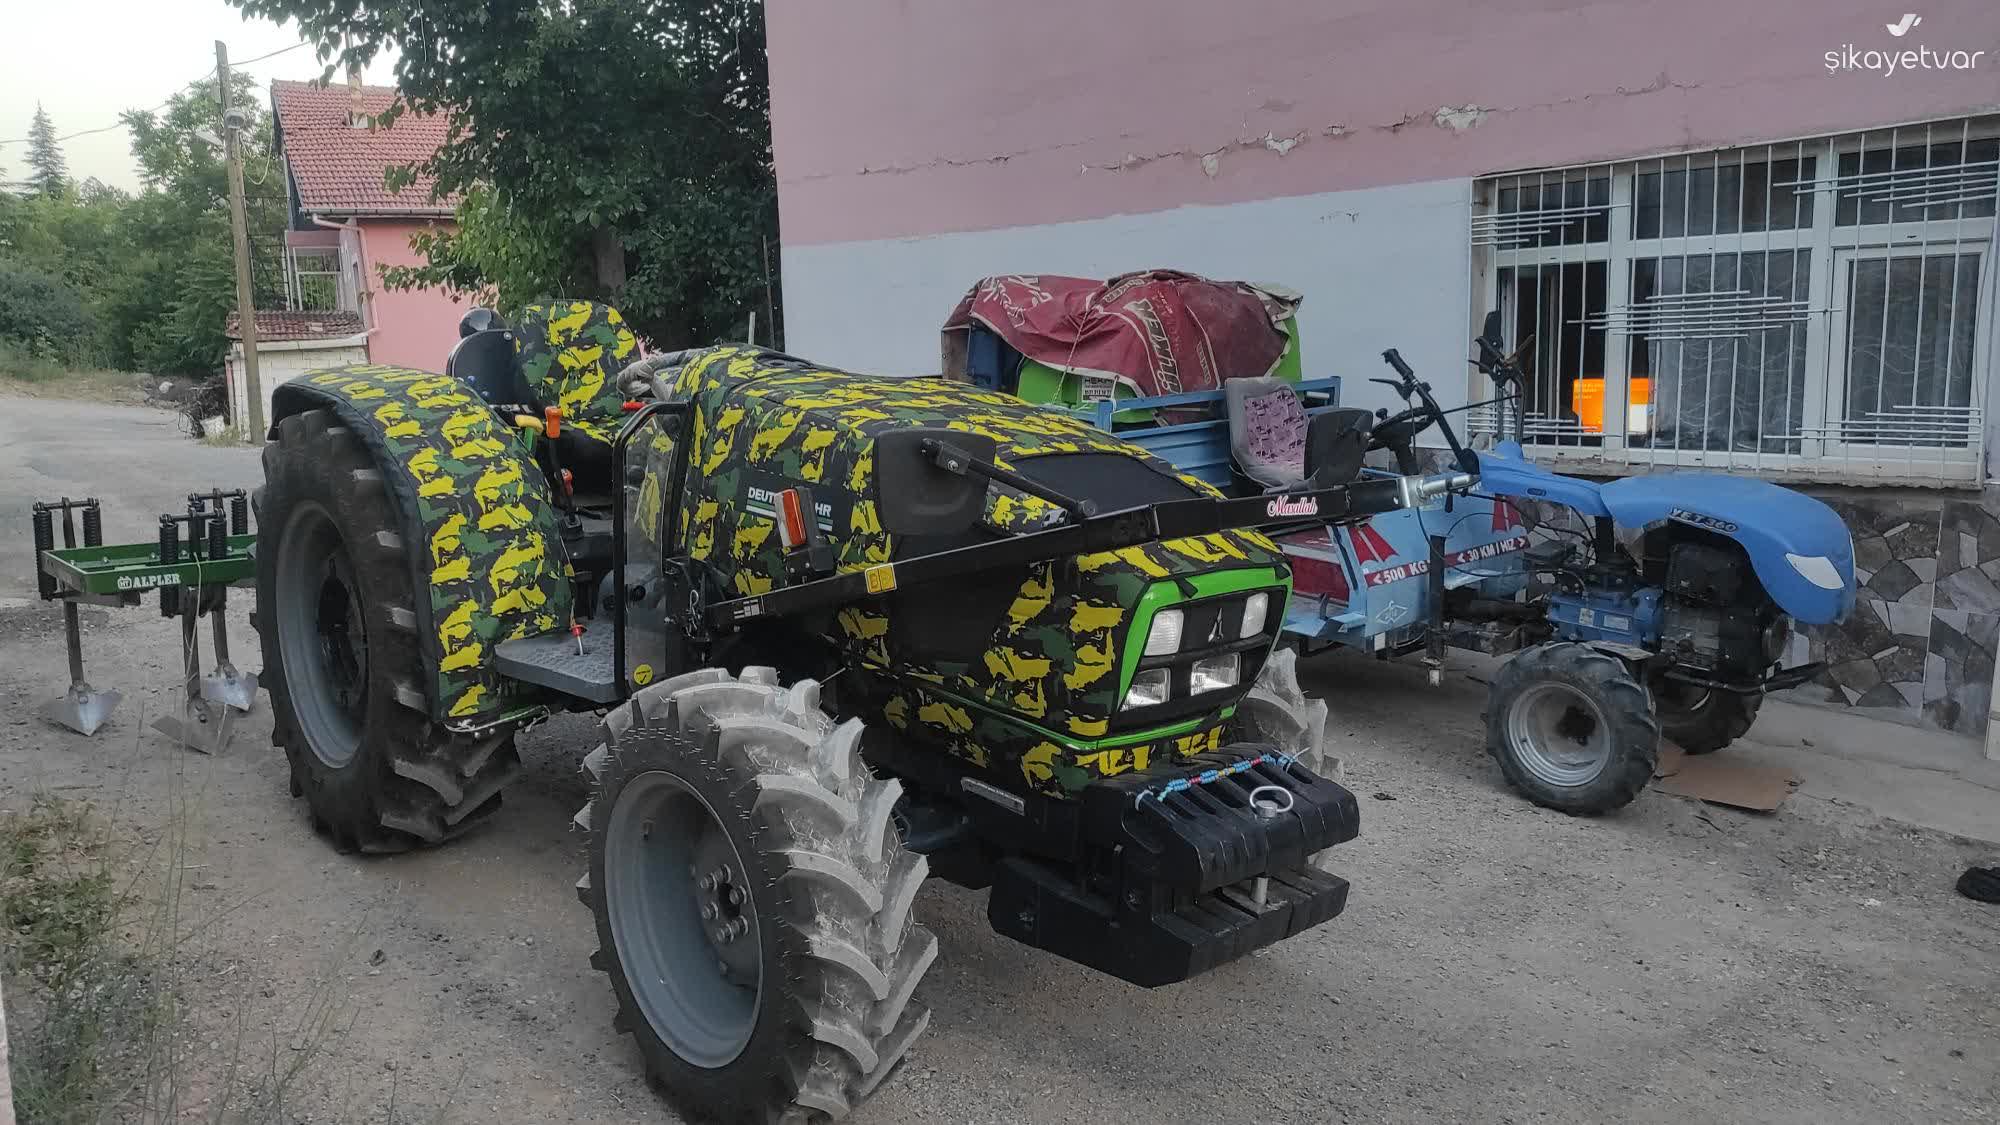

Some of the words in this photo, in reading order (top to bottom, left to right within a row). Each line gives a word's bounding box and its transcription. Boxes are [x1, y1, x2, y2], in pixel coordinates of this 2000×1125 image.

[1467, 549, 1480, 561] 30
[1480, 544, 1495, 558] KM
[1383, 566, 1406, 583] 500
[1409, 560, 1428, 576] KG
[133, 573, 181, 588] ALPLER
